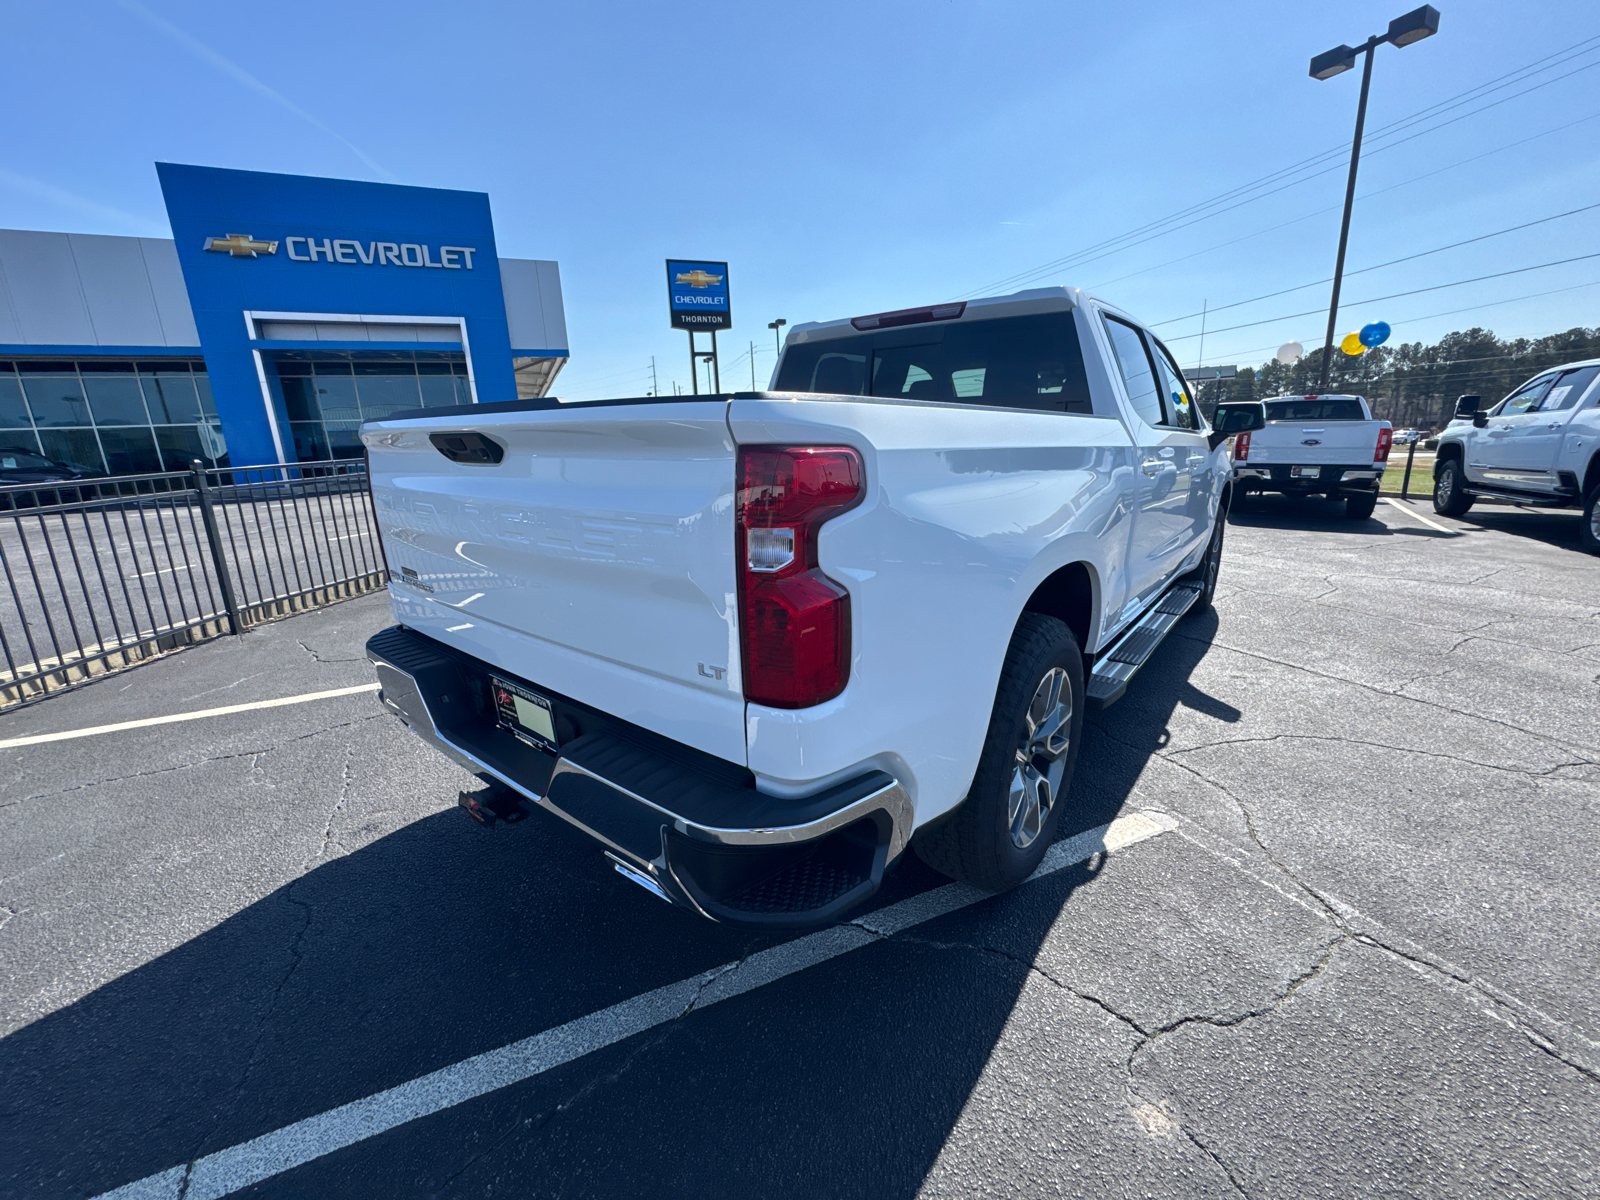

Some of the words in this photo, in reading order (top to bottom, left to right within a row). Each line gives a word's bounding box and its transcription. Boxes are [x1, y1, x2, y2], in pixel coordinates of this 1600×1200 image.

[286, 236, 476, 269] CHEVROLET
[674, 295, 725, 305] CHEVROLET
[697, 662, 727, 680] LT
